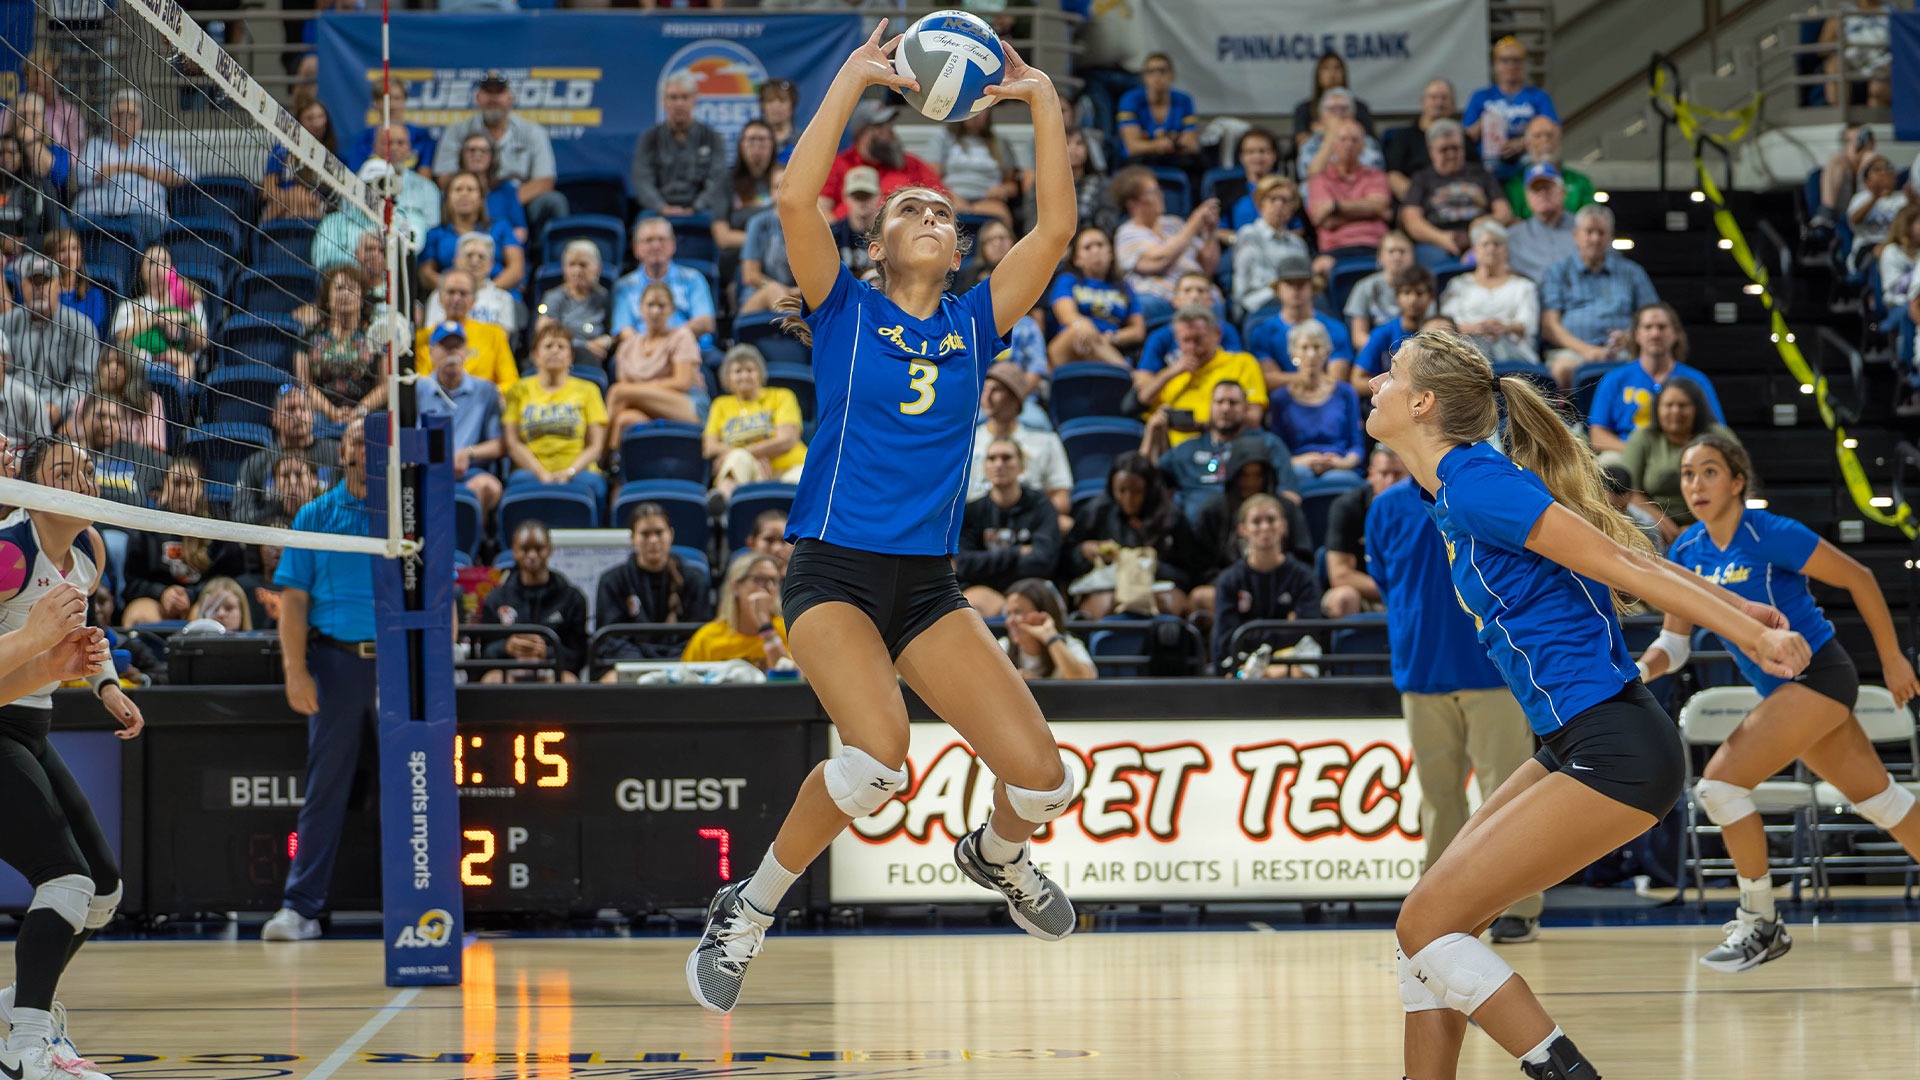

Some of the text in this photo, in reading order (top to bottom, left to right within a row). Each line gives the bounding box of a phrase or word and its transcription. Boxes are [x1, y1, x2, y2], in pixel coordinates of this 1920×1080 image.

[941, 16, 991, 44] NCAA
[932, 33, 960, 48] Super
[963, 43, 988, 62] Touch
[1217, 32, 1411, 61] PINNACLE BANK
[404, 79, 473, 108] LUE
[900, 358, 939, 415] 3
[615, 778, 747, 812] GUEST
[408, 751, 432, 890] sports imports
[508, 827, 529, 853] P
[698, 828, 731, 881] 7
[461, 830, 495, 886] 2
[1082, 861, 1222, 883] AIR DUCTS
[509, 863, 530, 889] B
